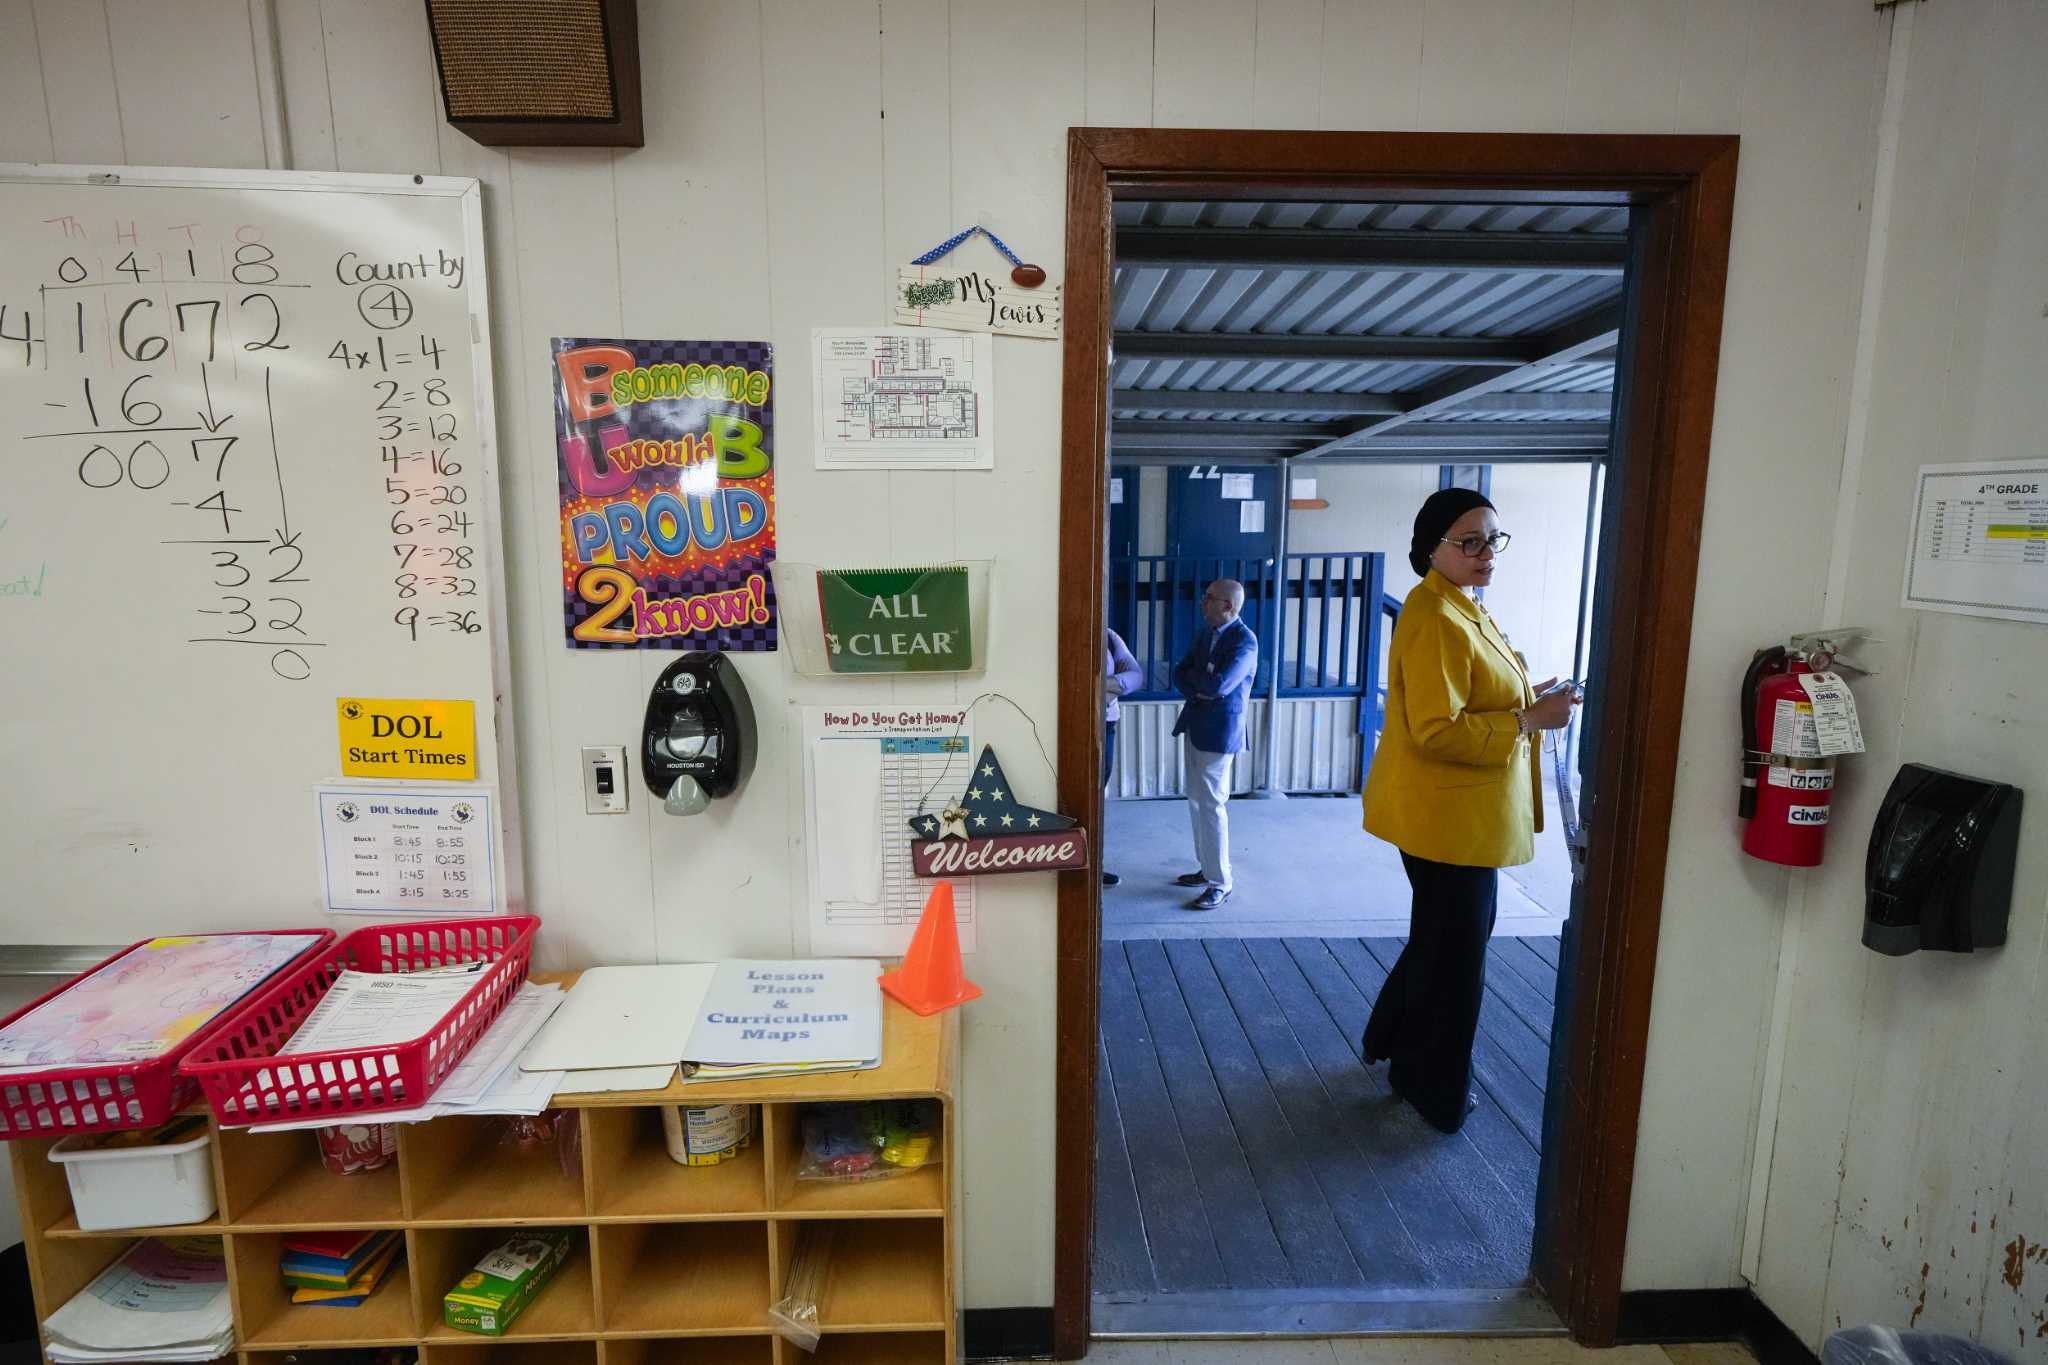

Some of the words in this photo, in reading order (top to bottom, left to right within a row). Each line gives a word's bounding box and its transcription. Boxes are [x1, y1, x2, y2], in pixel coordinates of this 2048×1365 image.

[116, 220, 138, 246] H
[168, 223, 200, 246] T
[336, 251, 435, 286] Count
[438, 249, 464, 289] by
[955, 271, 1002, 303] Ms.
[368, 290, 409, 321] 4
[986, 297, 1046, 329] Lewis
[556, 344, 636, 422] B
[611, 363, 770, 406] someone
[560, 423, 640, 498] U
[608, 431, 716, 473] would
[707, 413, 770, 480] B
[1996, 484, 2039, 494] GRADE
[570, 486, 769, 564] PROUD
[573, 564, 640, 643] 2
[631, 574, 770, 639] know!
[868, 594, 928, 619] ALL
[849, 632, 953, 656] CLEAR
[271, 649, 311, 681] 0
[370, 714, 443, 739] DOL
[824, 712, 849, 727] How
[852, 712, 869, 727] Do
[872, 711, 896, 726] You
[899, 711, 922, 726] Get
[925, 711, 966, 726] Home?
[349, 747, 399, 764] Start
[404, 748, 467, 766] Times
[370, 805, 391, 815] DOL
[394, 806, 439, 817] Schedule
[436, 837, 465, 848] 8:55
[394, 853, 424, 864] 10:15
[434, 854, 465, 865] 10:25
[922, 839, 1077, 874] Welcome
[443, 871, 467, 882] 1:55
[400, 887, 425, 898] 3:15
[747, 970, 824, 981] Lesson
[752, 984, 815, 994] Plans
[772, 1000, 790, 1009] &
[706, 1012, 849, 1025] Curriculum
[740, 1029, 810, 1042] Maps
[454, 1316, 480, 1327] Money
